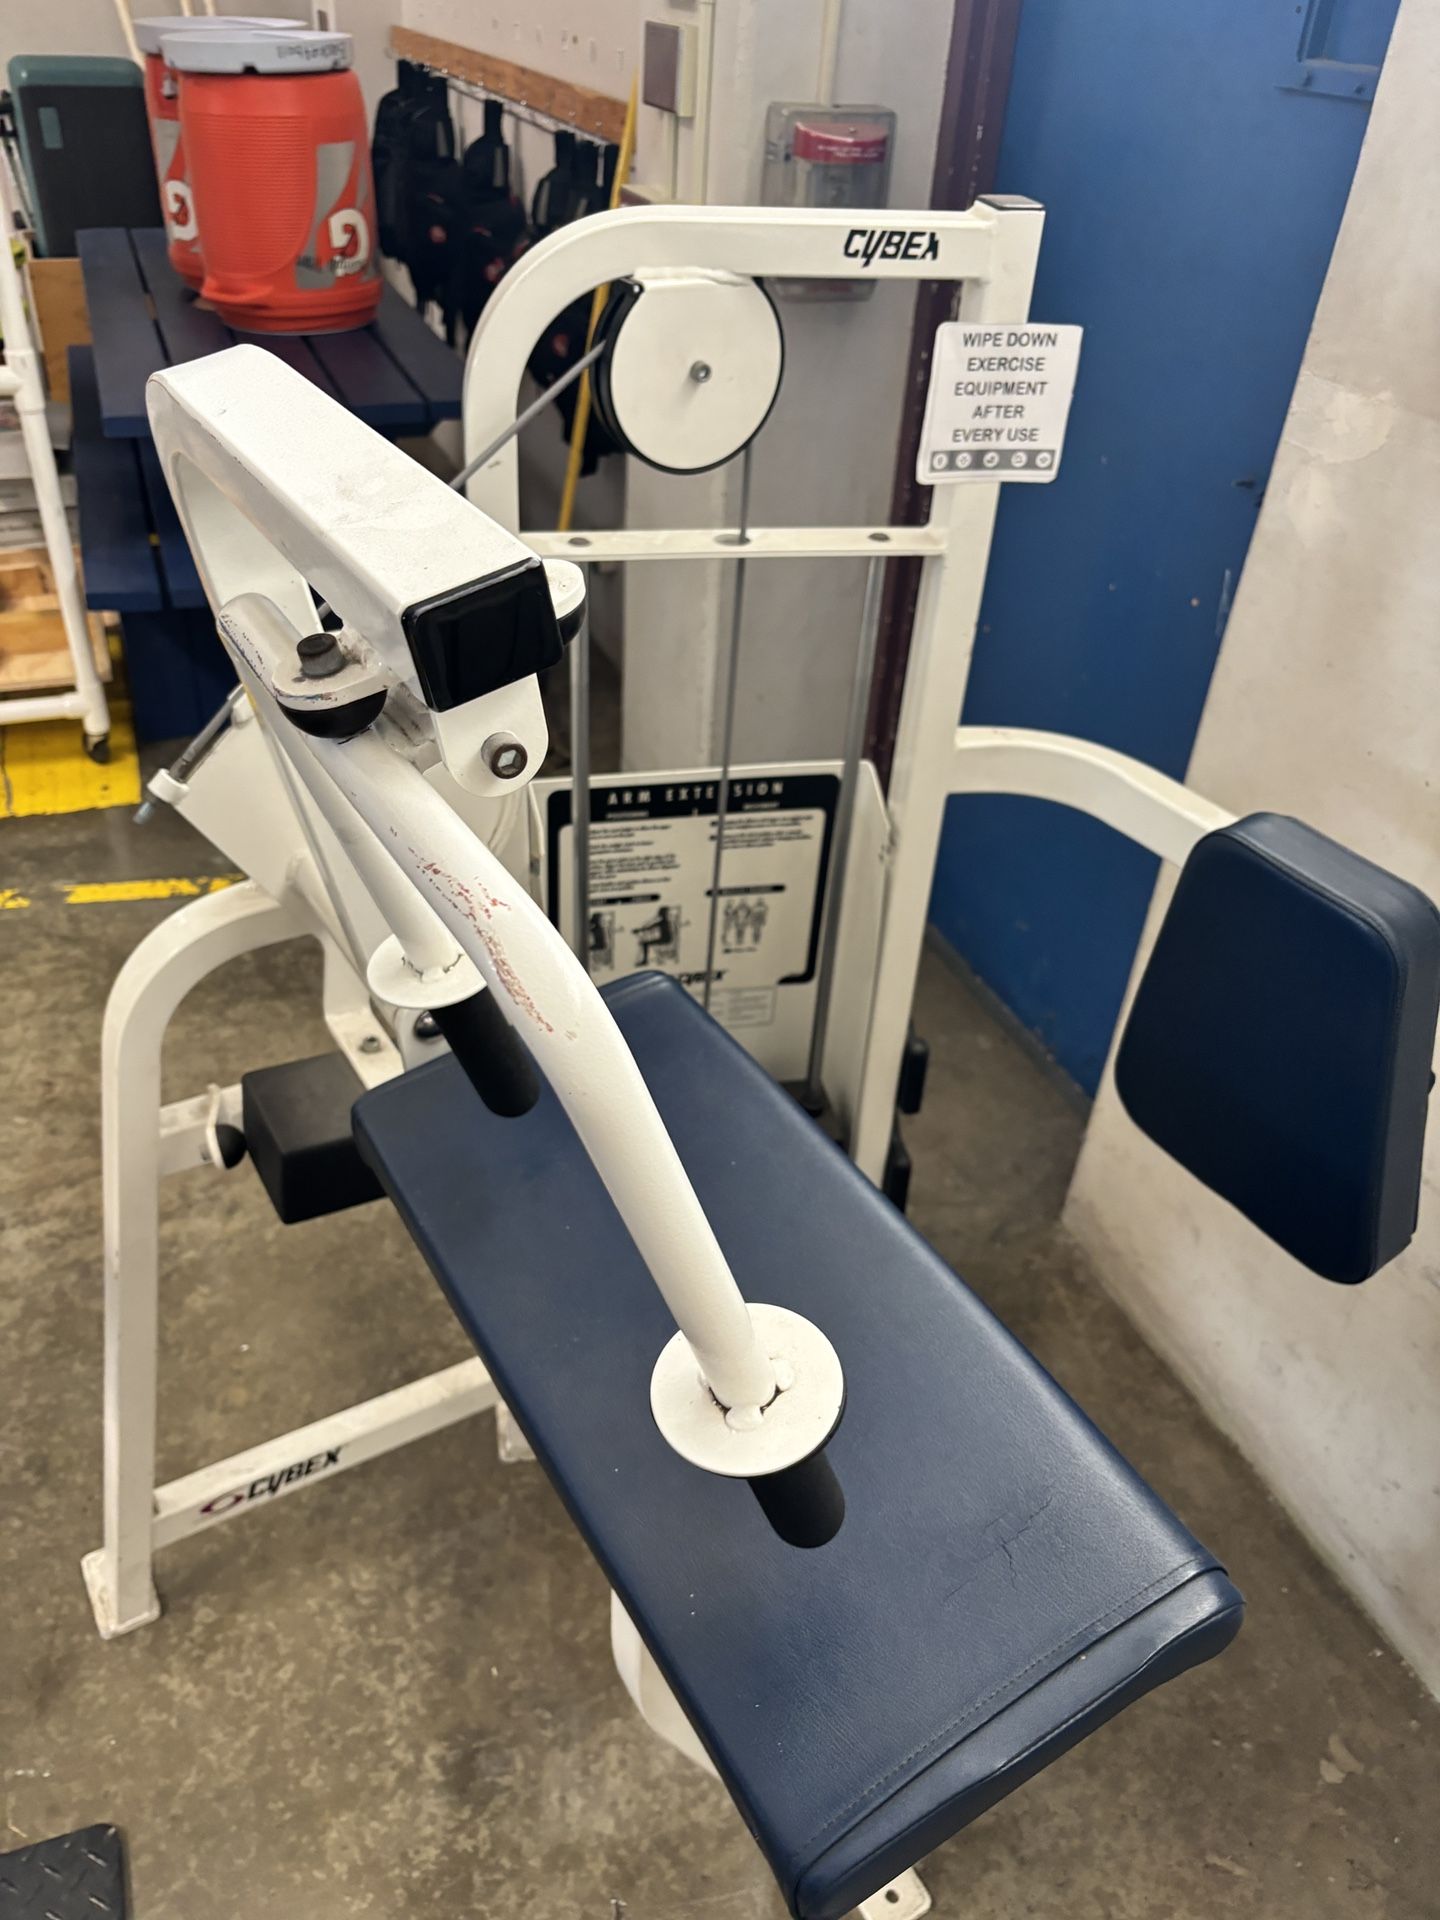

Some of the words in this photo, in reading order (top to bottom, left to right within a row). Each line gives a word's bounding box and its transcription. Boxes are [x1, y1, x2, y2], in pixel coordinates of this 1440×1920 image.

[843, 229, 940, 268] CYBEX
[963, 332, 1003, 348] WIPE
[1006, 332, 1058, 348] DOWN
[966, 356, 1046, 372] EXERCISE
[954, 381, 1048, 397] EQUIPMENT
[971, 404, 1025, 420] AFTER
[951, 428, 1003, 443] EVERY
[1006, 427, 1040, 442] USE
[607, 790, 651, 806] ARM
[664, 781, 783, 802] EXTESION
[247, 1446, 342, 1500] CYBEX
